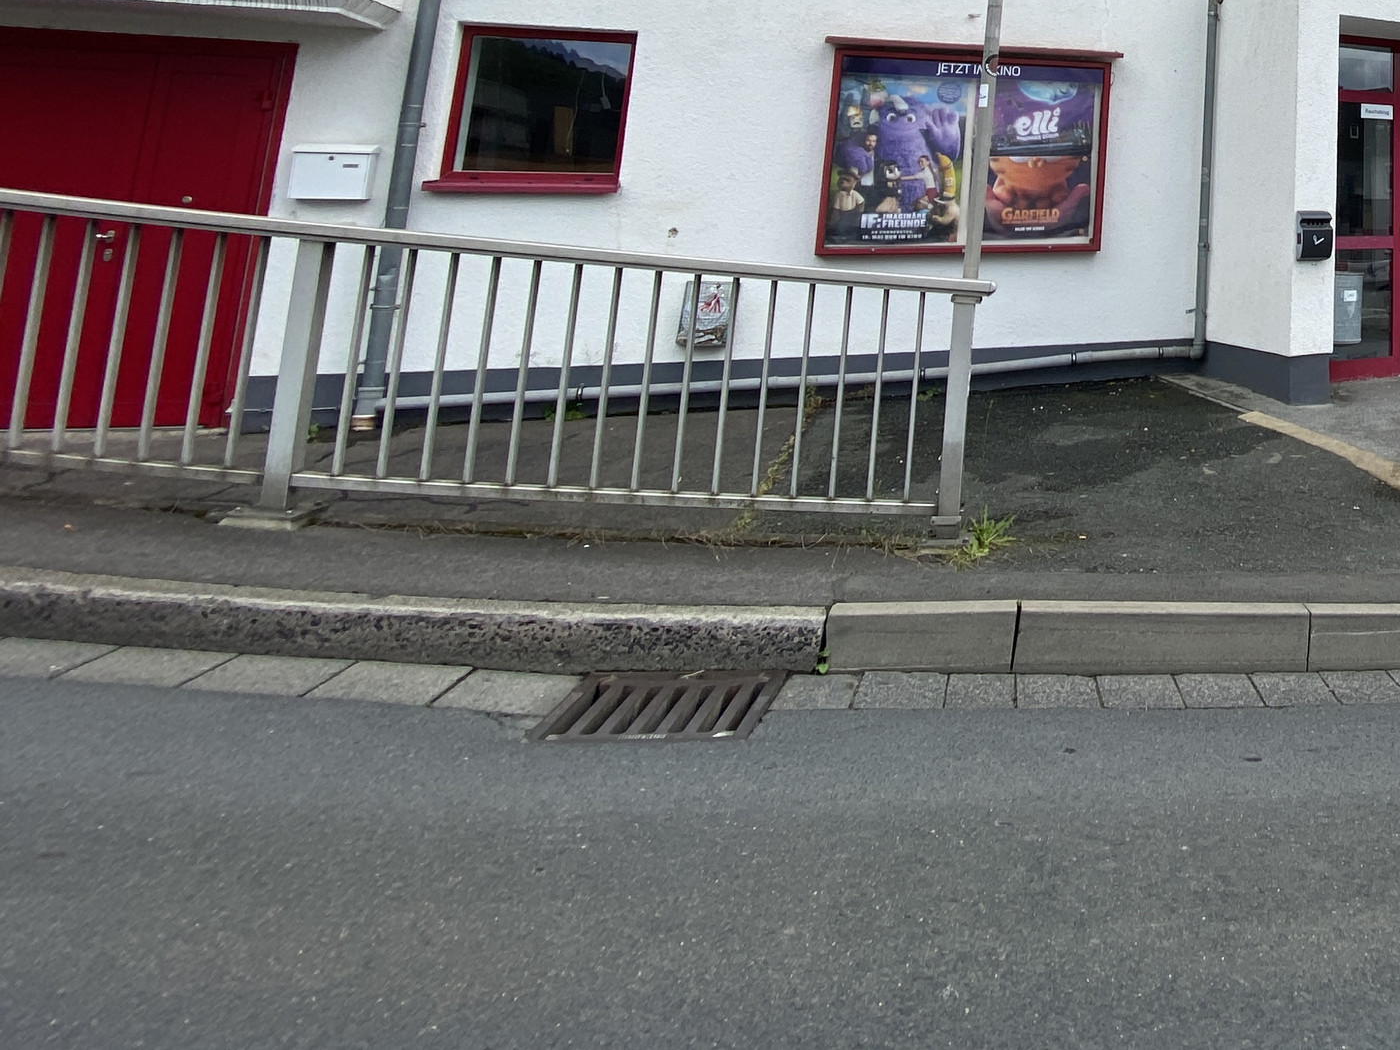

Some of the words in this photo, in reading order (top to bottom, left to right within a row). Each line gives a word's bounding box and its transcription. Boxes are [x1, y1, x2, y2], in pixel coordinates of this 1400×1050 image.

[936, 62, 971, 76] JETZT
[1014, 107, 1060, 136] elli
[1001, 207, 1060, 221] GARFIELD
[882, 219, 927, 228] FREUNDE
